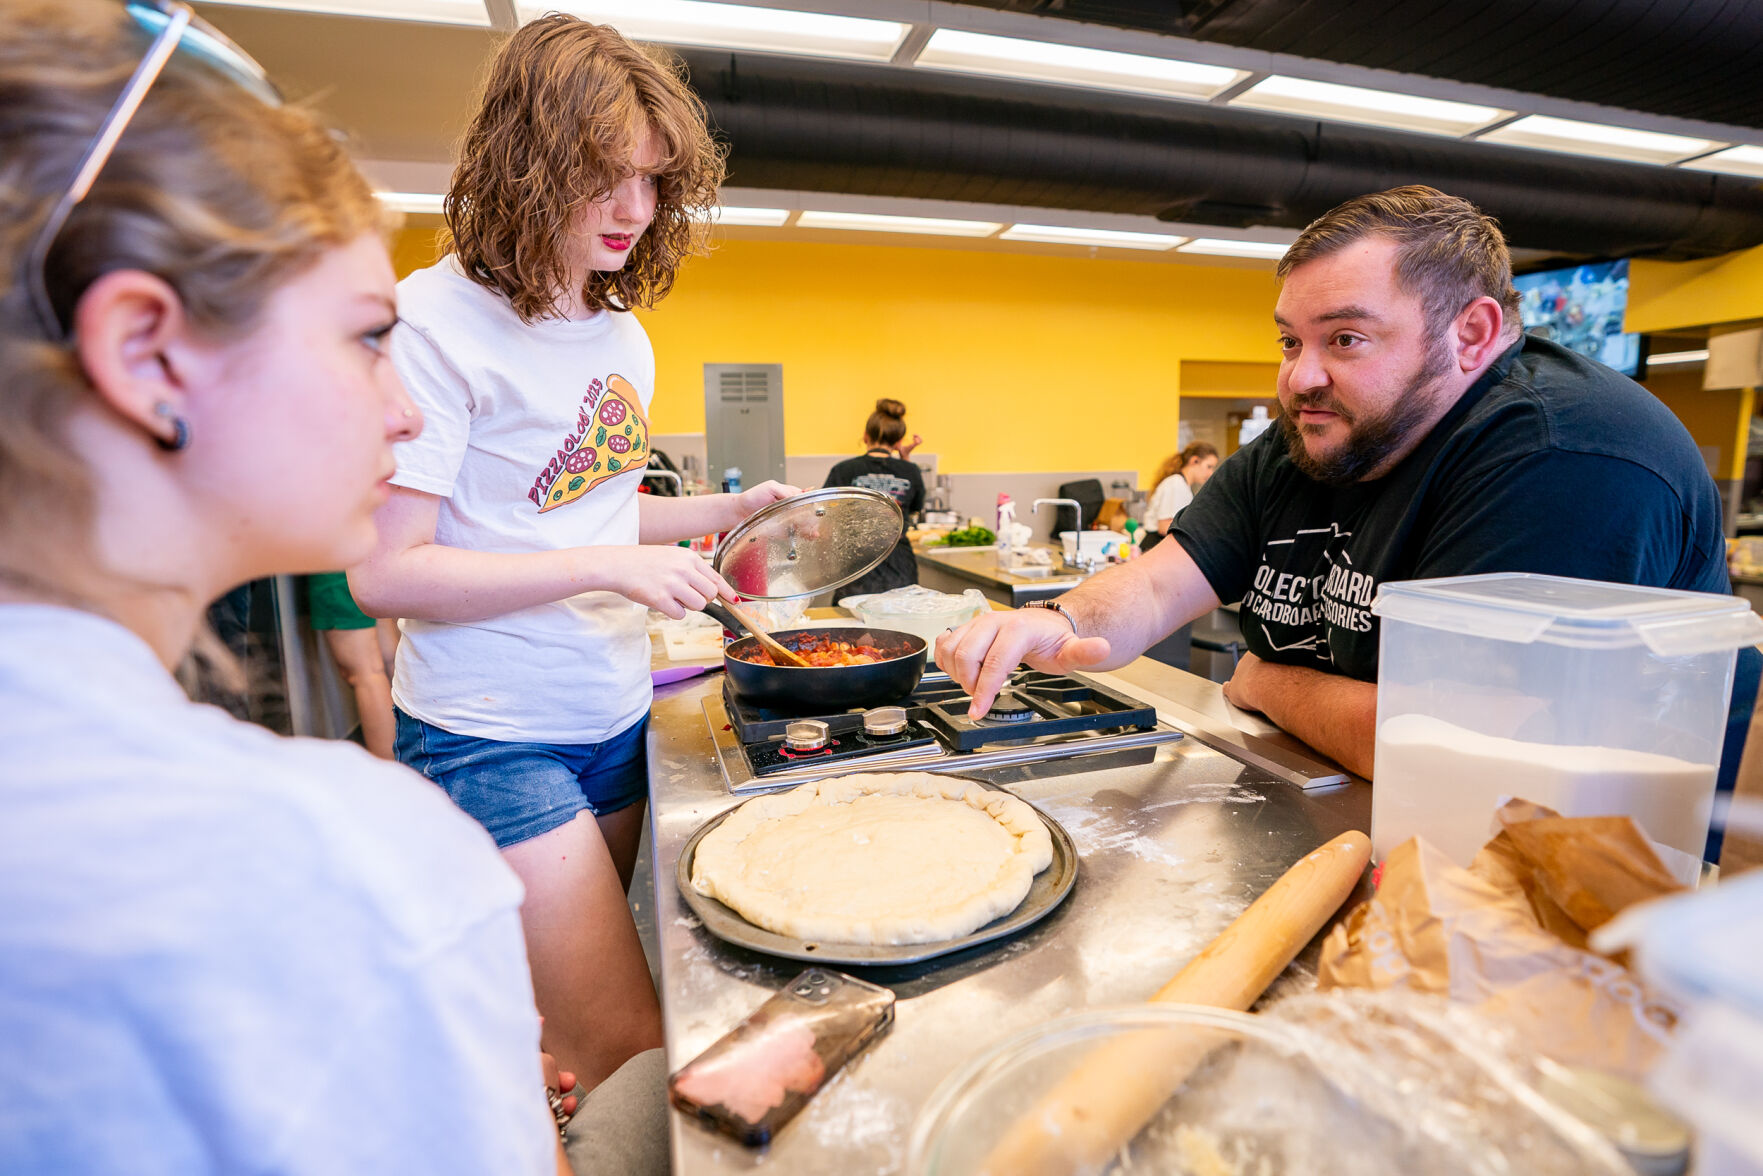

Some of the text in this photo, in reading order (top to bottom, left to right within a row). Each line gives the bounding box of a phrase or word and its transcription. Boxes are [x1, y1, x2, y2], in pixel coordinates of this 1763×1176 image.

[528, 378, 603, 507] PIZZAOLOGY 2023
[1252, 594, 1322, 627] CARDBOA
